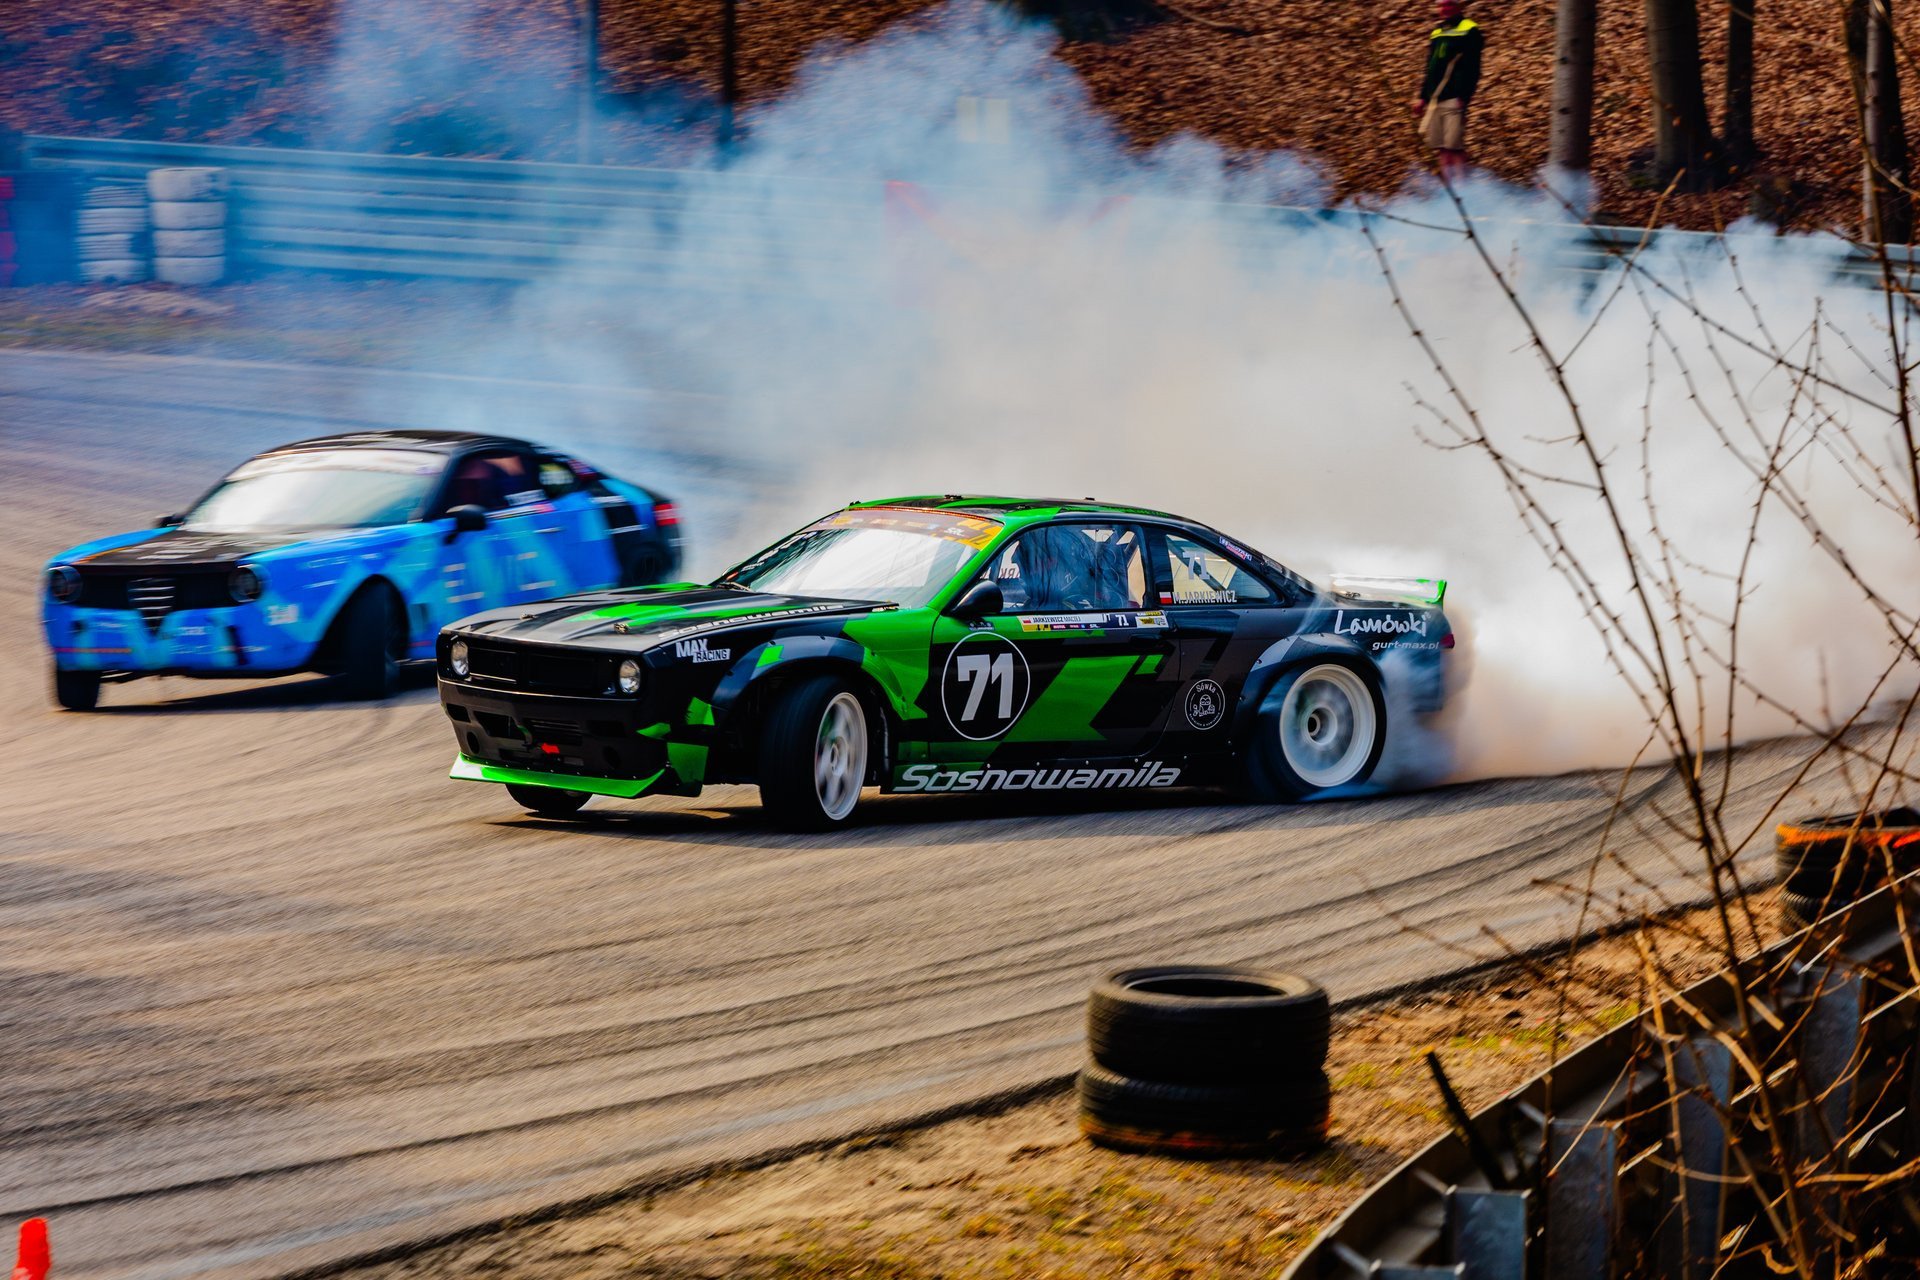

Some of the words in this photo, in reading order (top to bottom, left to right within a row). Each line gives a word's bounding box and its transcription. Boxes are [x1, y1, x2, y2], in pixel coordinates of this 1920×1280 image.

[1183, 549, 1210, 580] 71
[1115, 614, 1129, 626] 71
[1334, 610, 1427, 637] Lamówki
[676, 638, 708, 658] MAX
[696, 649, 729, 662] RACING
[1372, 641, 1440, 651] gurt-max.pl
[957, 653, 1014, 722] 71
[893, 761, 1181, 792] Sosnowamila
